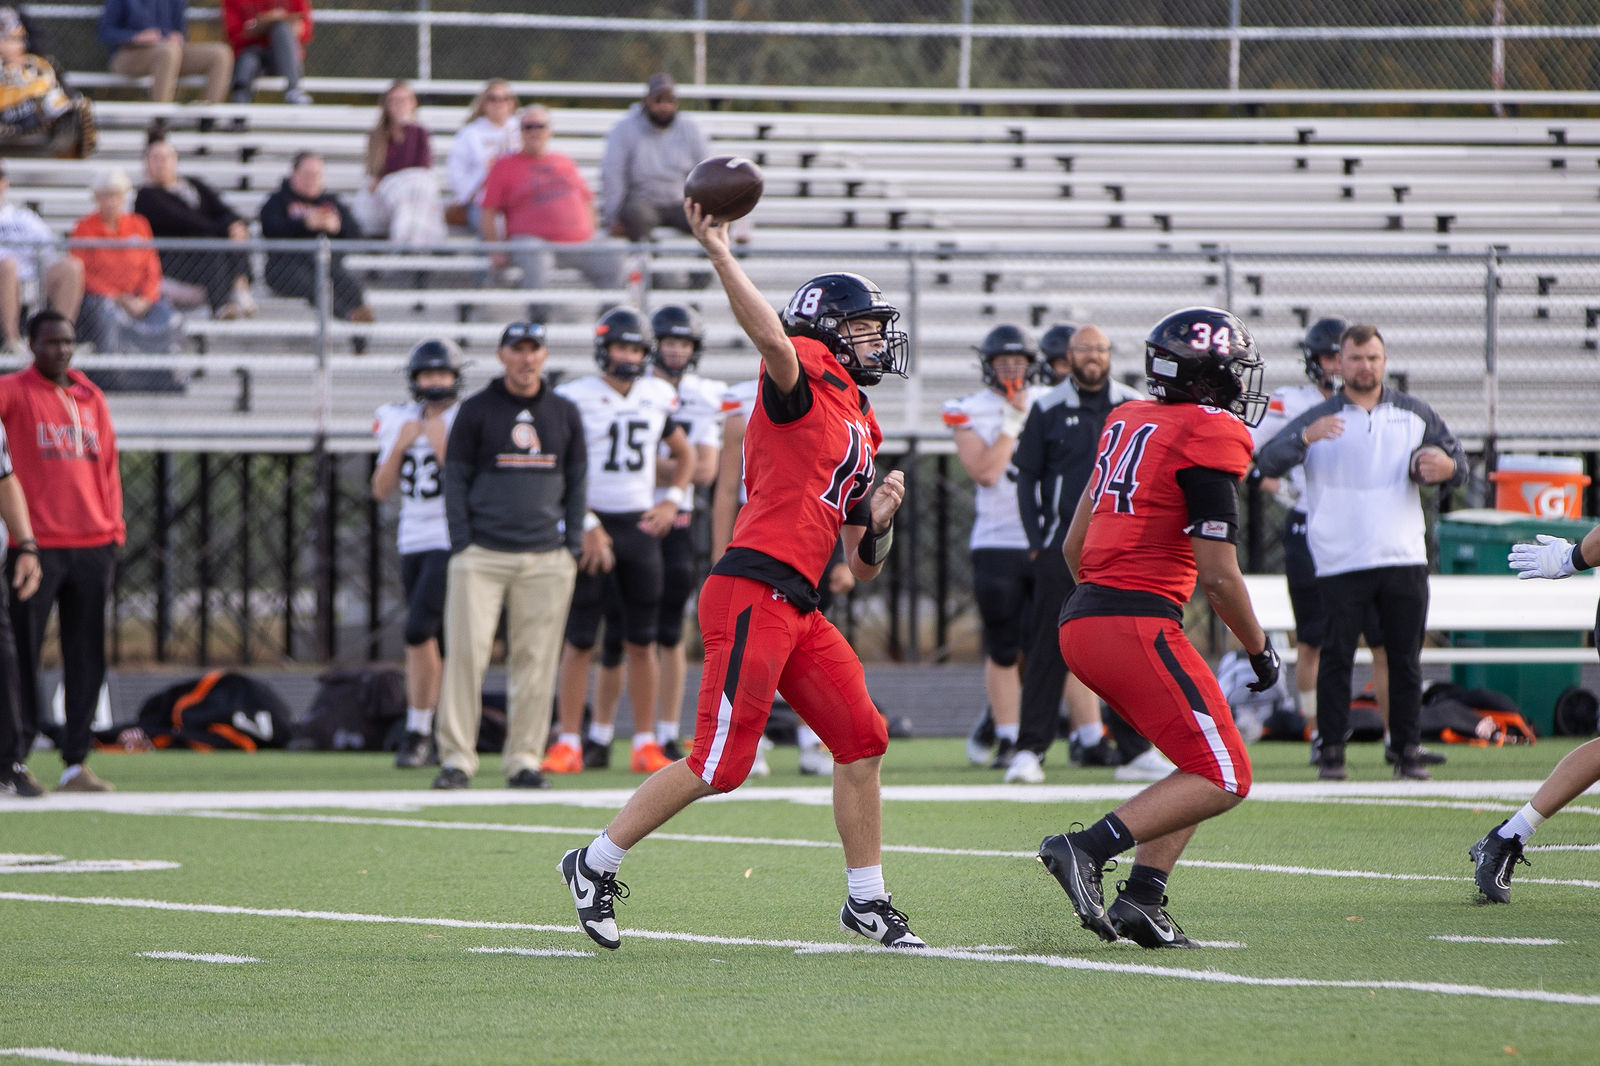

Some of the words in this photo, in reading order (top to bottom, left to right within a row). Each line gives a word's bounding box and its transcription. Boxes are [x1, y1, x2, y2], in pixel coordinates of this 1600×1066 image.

[789, 287, 823, 316] 18
[1190, 322, 1231, 355] 34
[604, 421, 650, 472] 15
[1090, 420, 1158, 515] 34
